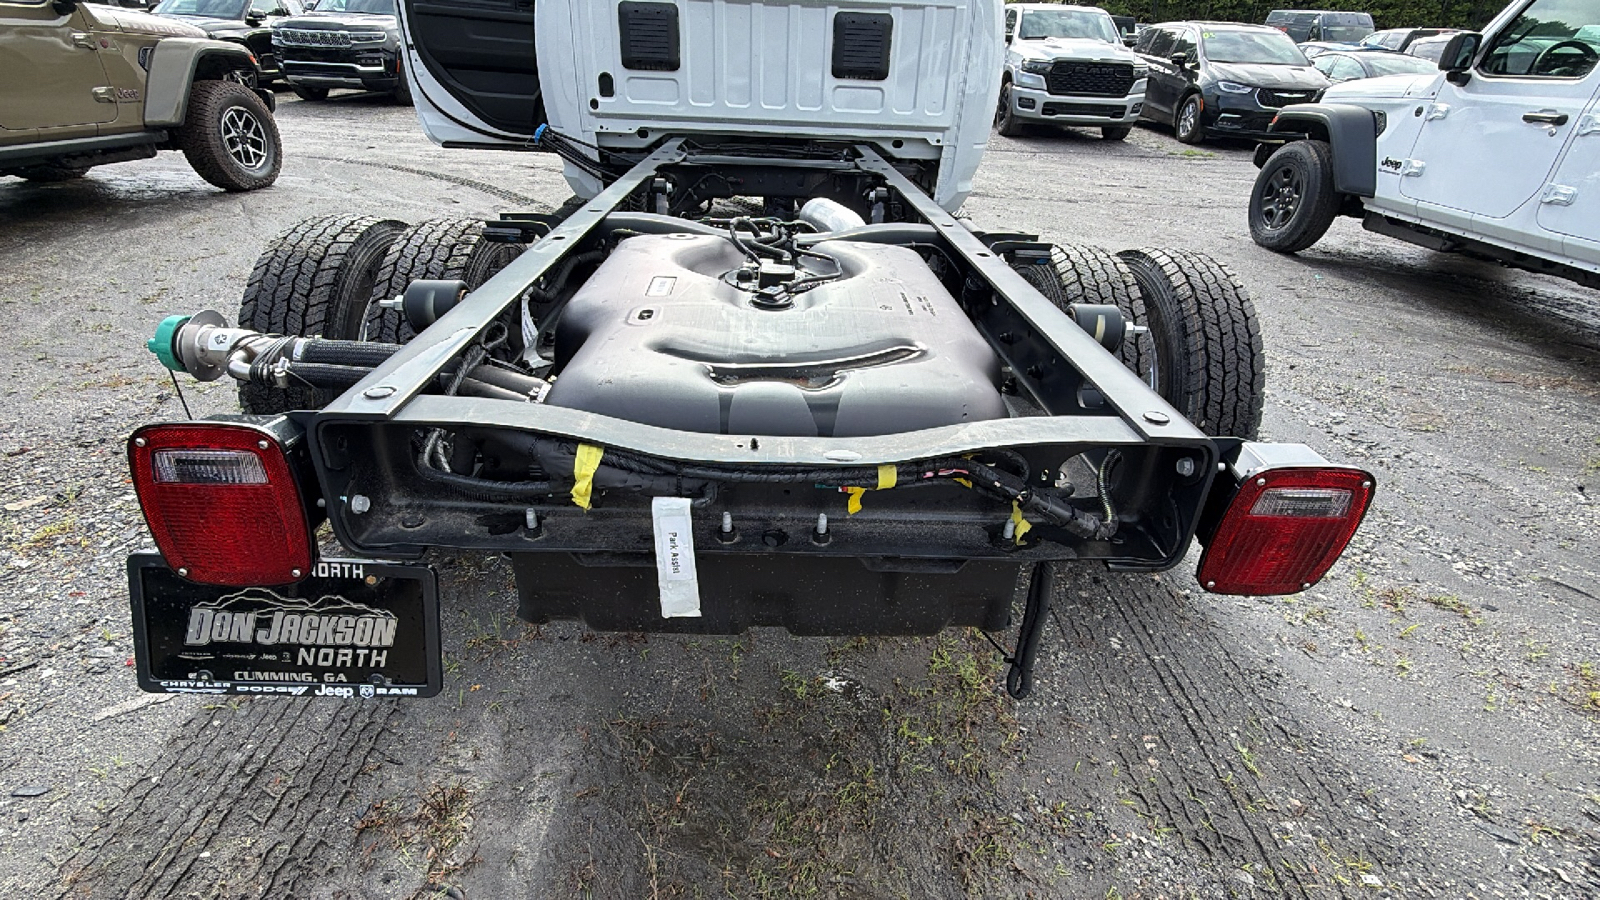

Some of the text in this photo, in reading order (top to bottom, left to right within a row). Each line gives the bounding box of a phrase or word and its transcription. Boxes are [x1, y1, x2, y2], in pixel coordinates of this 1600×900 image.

[1074, 66, 1115, 75] RAM
[116, 87, 140, 100] Jeep
[1381, 156, 1402, 171] Jeep
[668, 532, 679, 550] Park
[297, 647, 388, 667] NORTH
[323, 672, 348, 682] GA
[314, 684, 354, 699] Jeep
[376, 687, 418, 696] RAM
